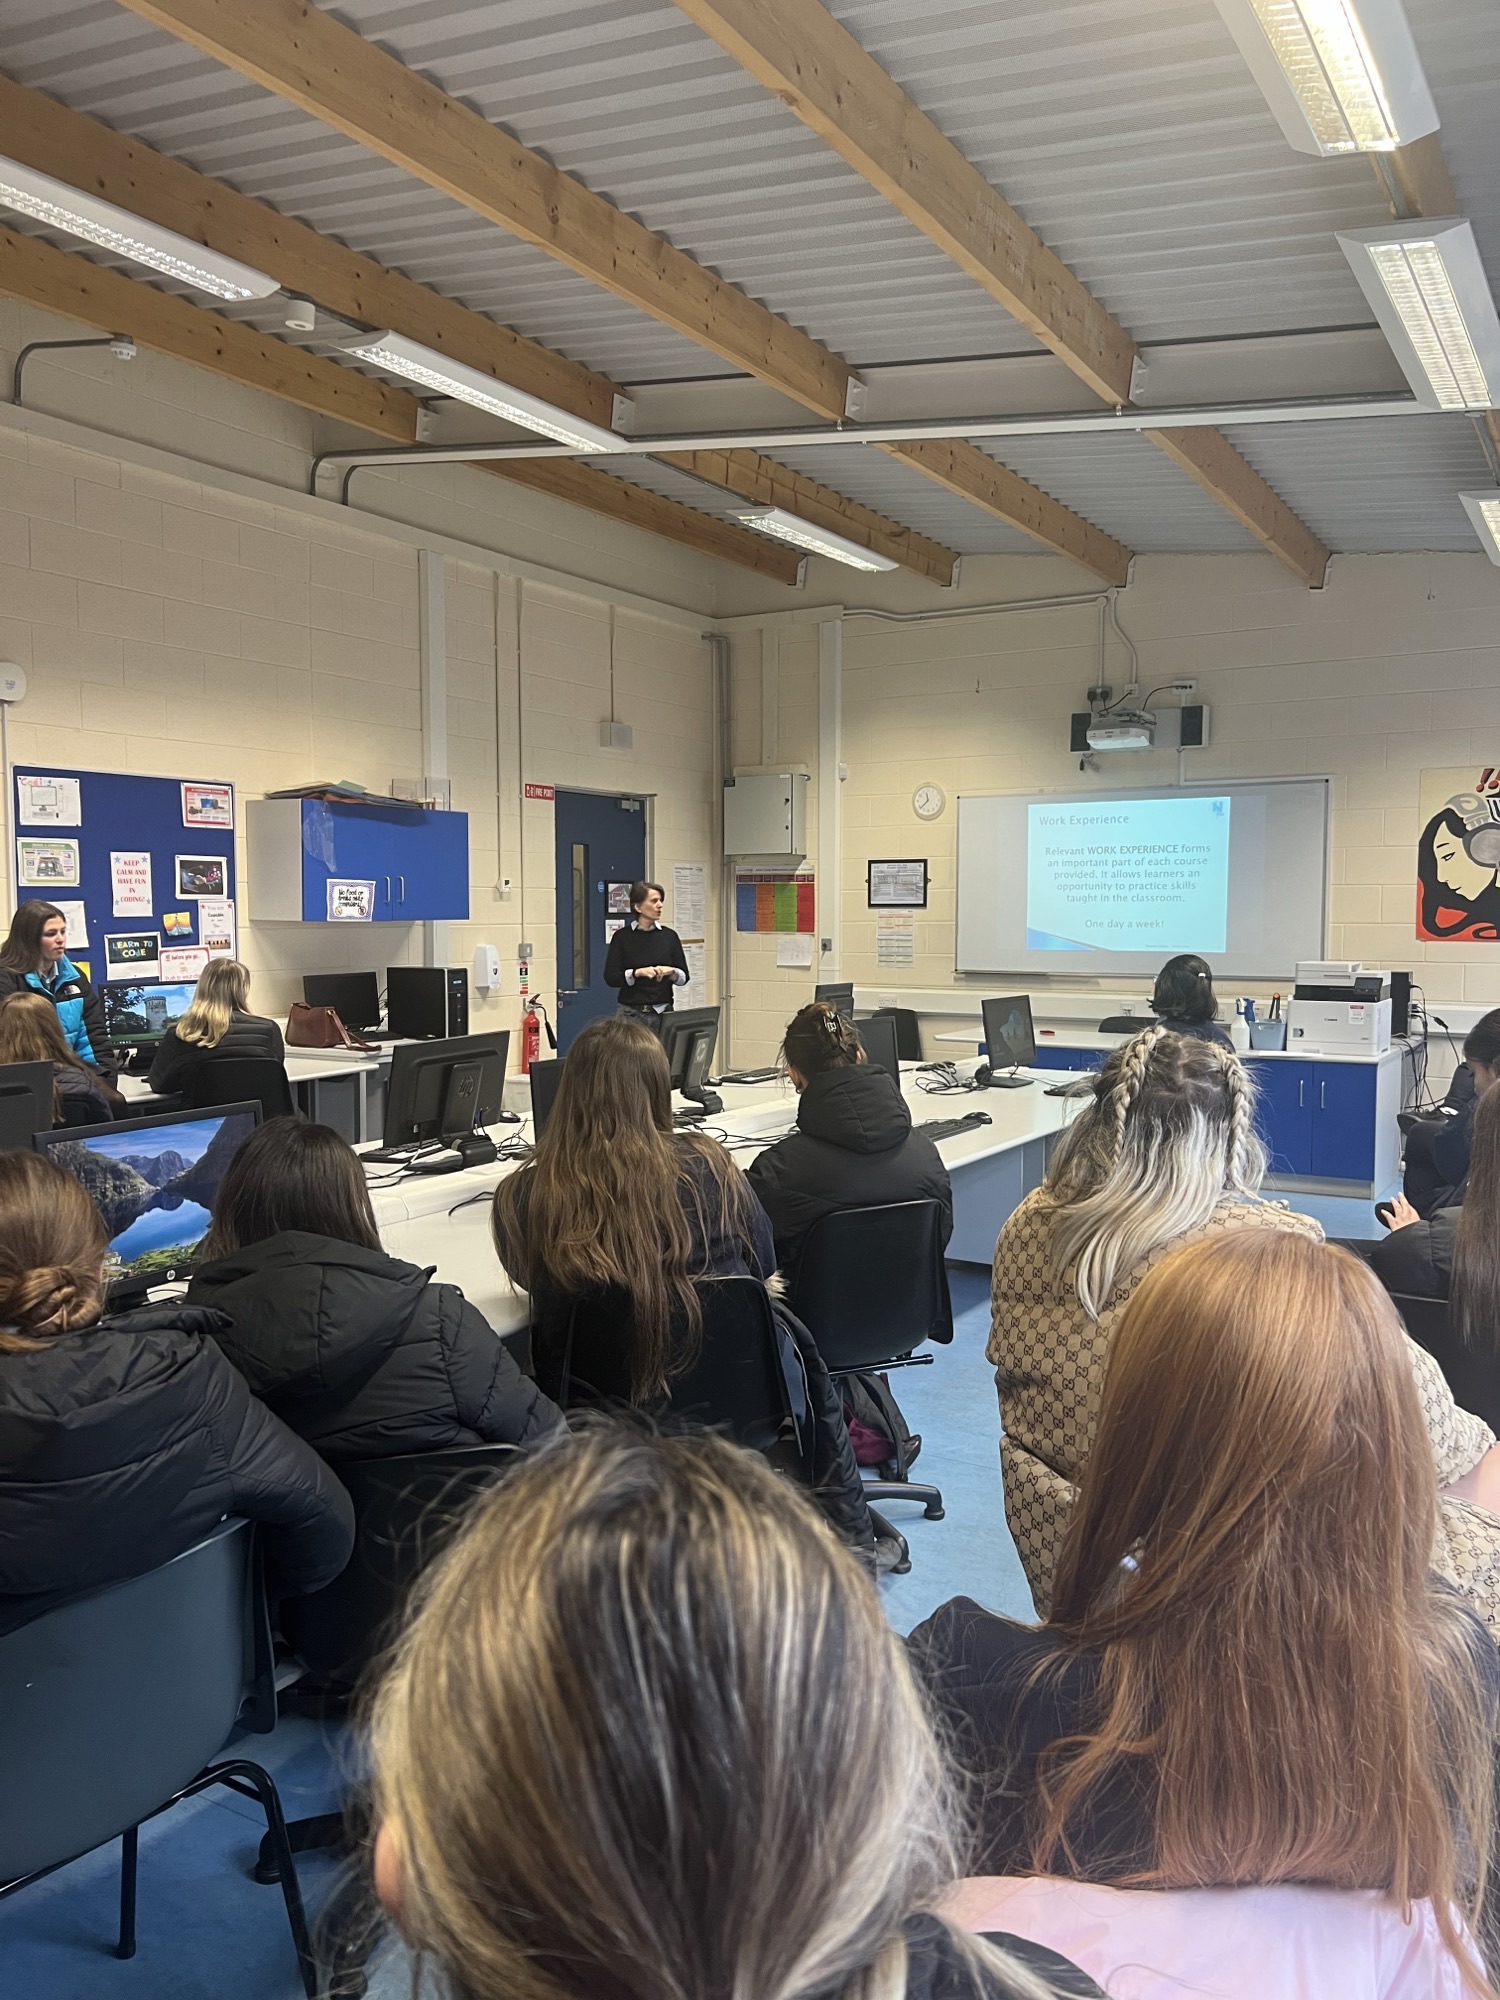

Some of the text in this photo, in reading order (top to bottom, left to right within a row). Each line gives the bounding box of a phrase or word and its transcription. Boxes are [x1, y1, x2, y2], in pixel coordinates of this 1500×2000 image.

[1039, 815, 1129, 827] Work Experience
[1045, 843, 1211, 856] Relevant WORK EXPERIENCE forms
[1061, 859, 1109, 868] important
[1111, 859, 1132, 868] part
[1134, 857, 1145, 866] of
[1147, 857, 1171, 866] each
[1174, 857, 1208, 865] course
[1054, 870, 1098, 880] provided.
[1101, 870, 1108, 878] It
[1110, 869, 1141, 878] allows
[1144, 869, 1185, 878] learners
[1057, 882, 1112, 892] opportunity
[1128, 881, 1168, 892] practice
[1170, 881, 1197, 890] skills
[1066, 893, 1185, 904] taught in the classroom.
[1084, 919, 1104, 928] One
[1107, 919, 1124, 930] day
[1135, 919, 1164, 929] week!
